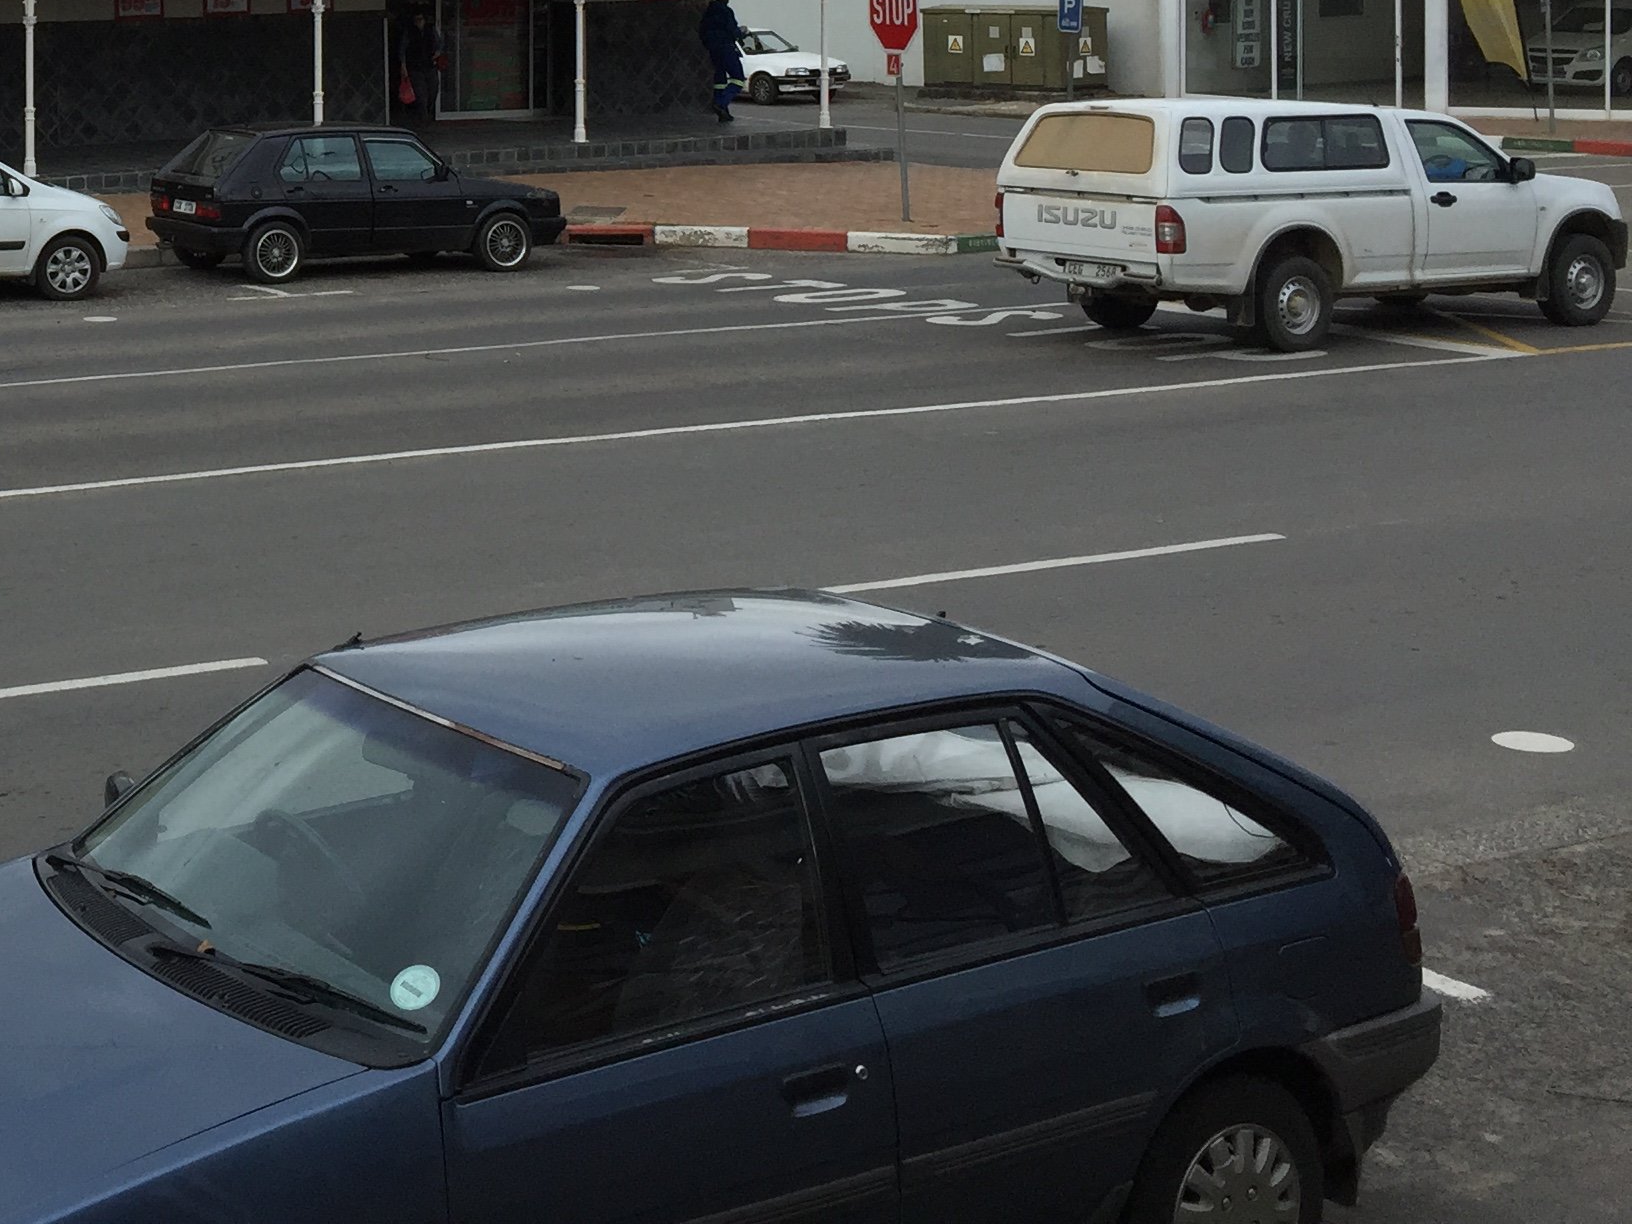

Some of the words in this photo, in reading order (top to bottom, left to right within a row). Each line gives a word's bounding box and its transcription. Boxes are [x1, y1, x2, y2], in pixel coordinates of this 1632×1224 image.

[1283, 31, 1293, 62] NEW
[889, 56, 898, 74] 4
[1037, 203, 1117, 230] ISUZU
